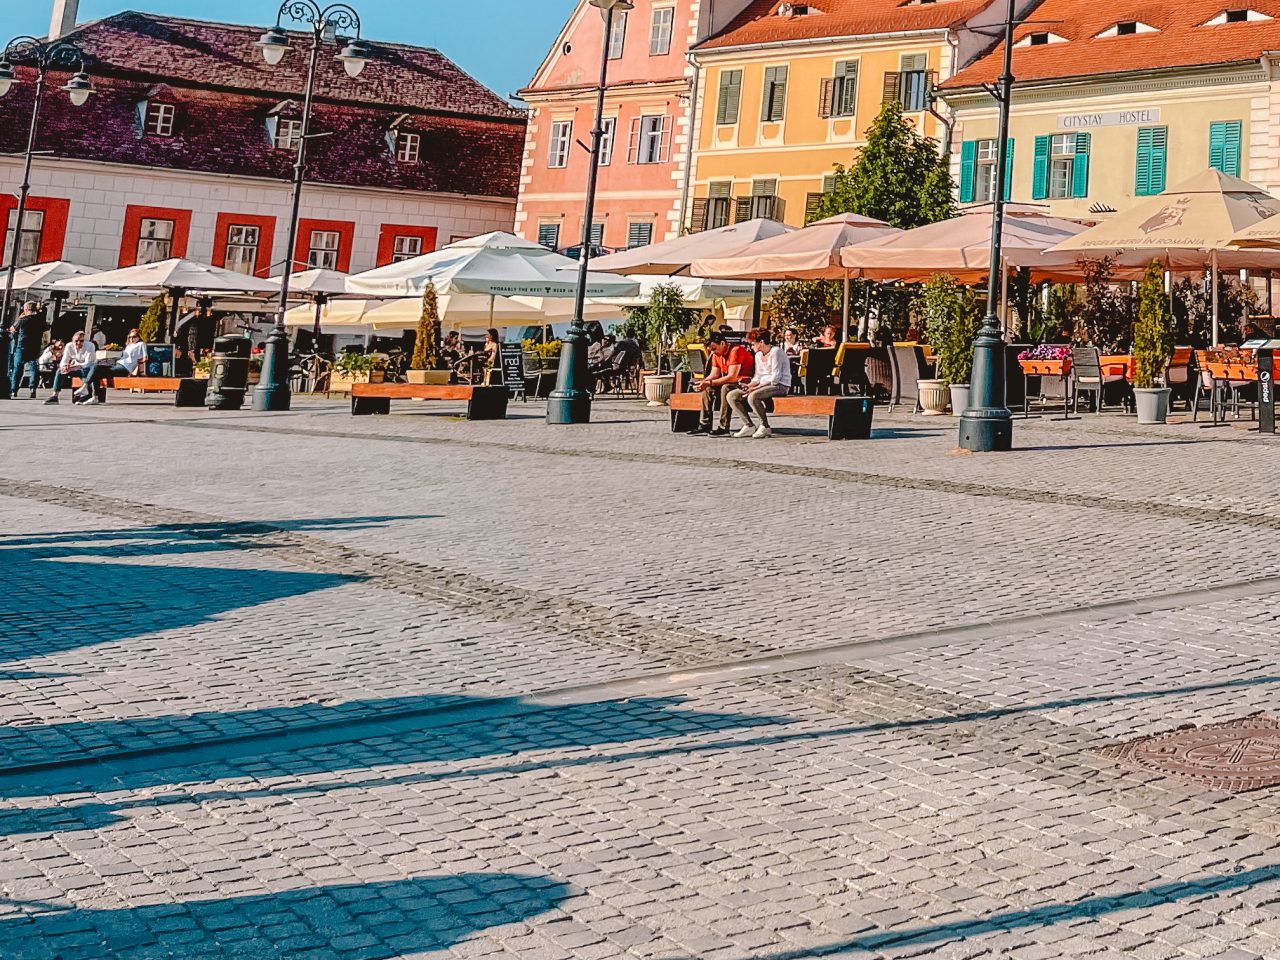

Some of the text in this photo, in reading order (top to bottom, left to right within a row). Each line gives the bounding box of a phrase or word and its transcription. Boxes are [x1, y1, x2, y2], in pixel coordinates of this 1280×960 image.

[1063, 110, 1152, 128] CITYSTAY HOSTEL
[1262, 381, 1270, 403] pepsi
